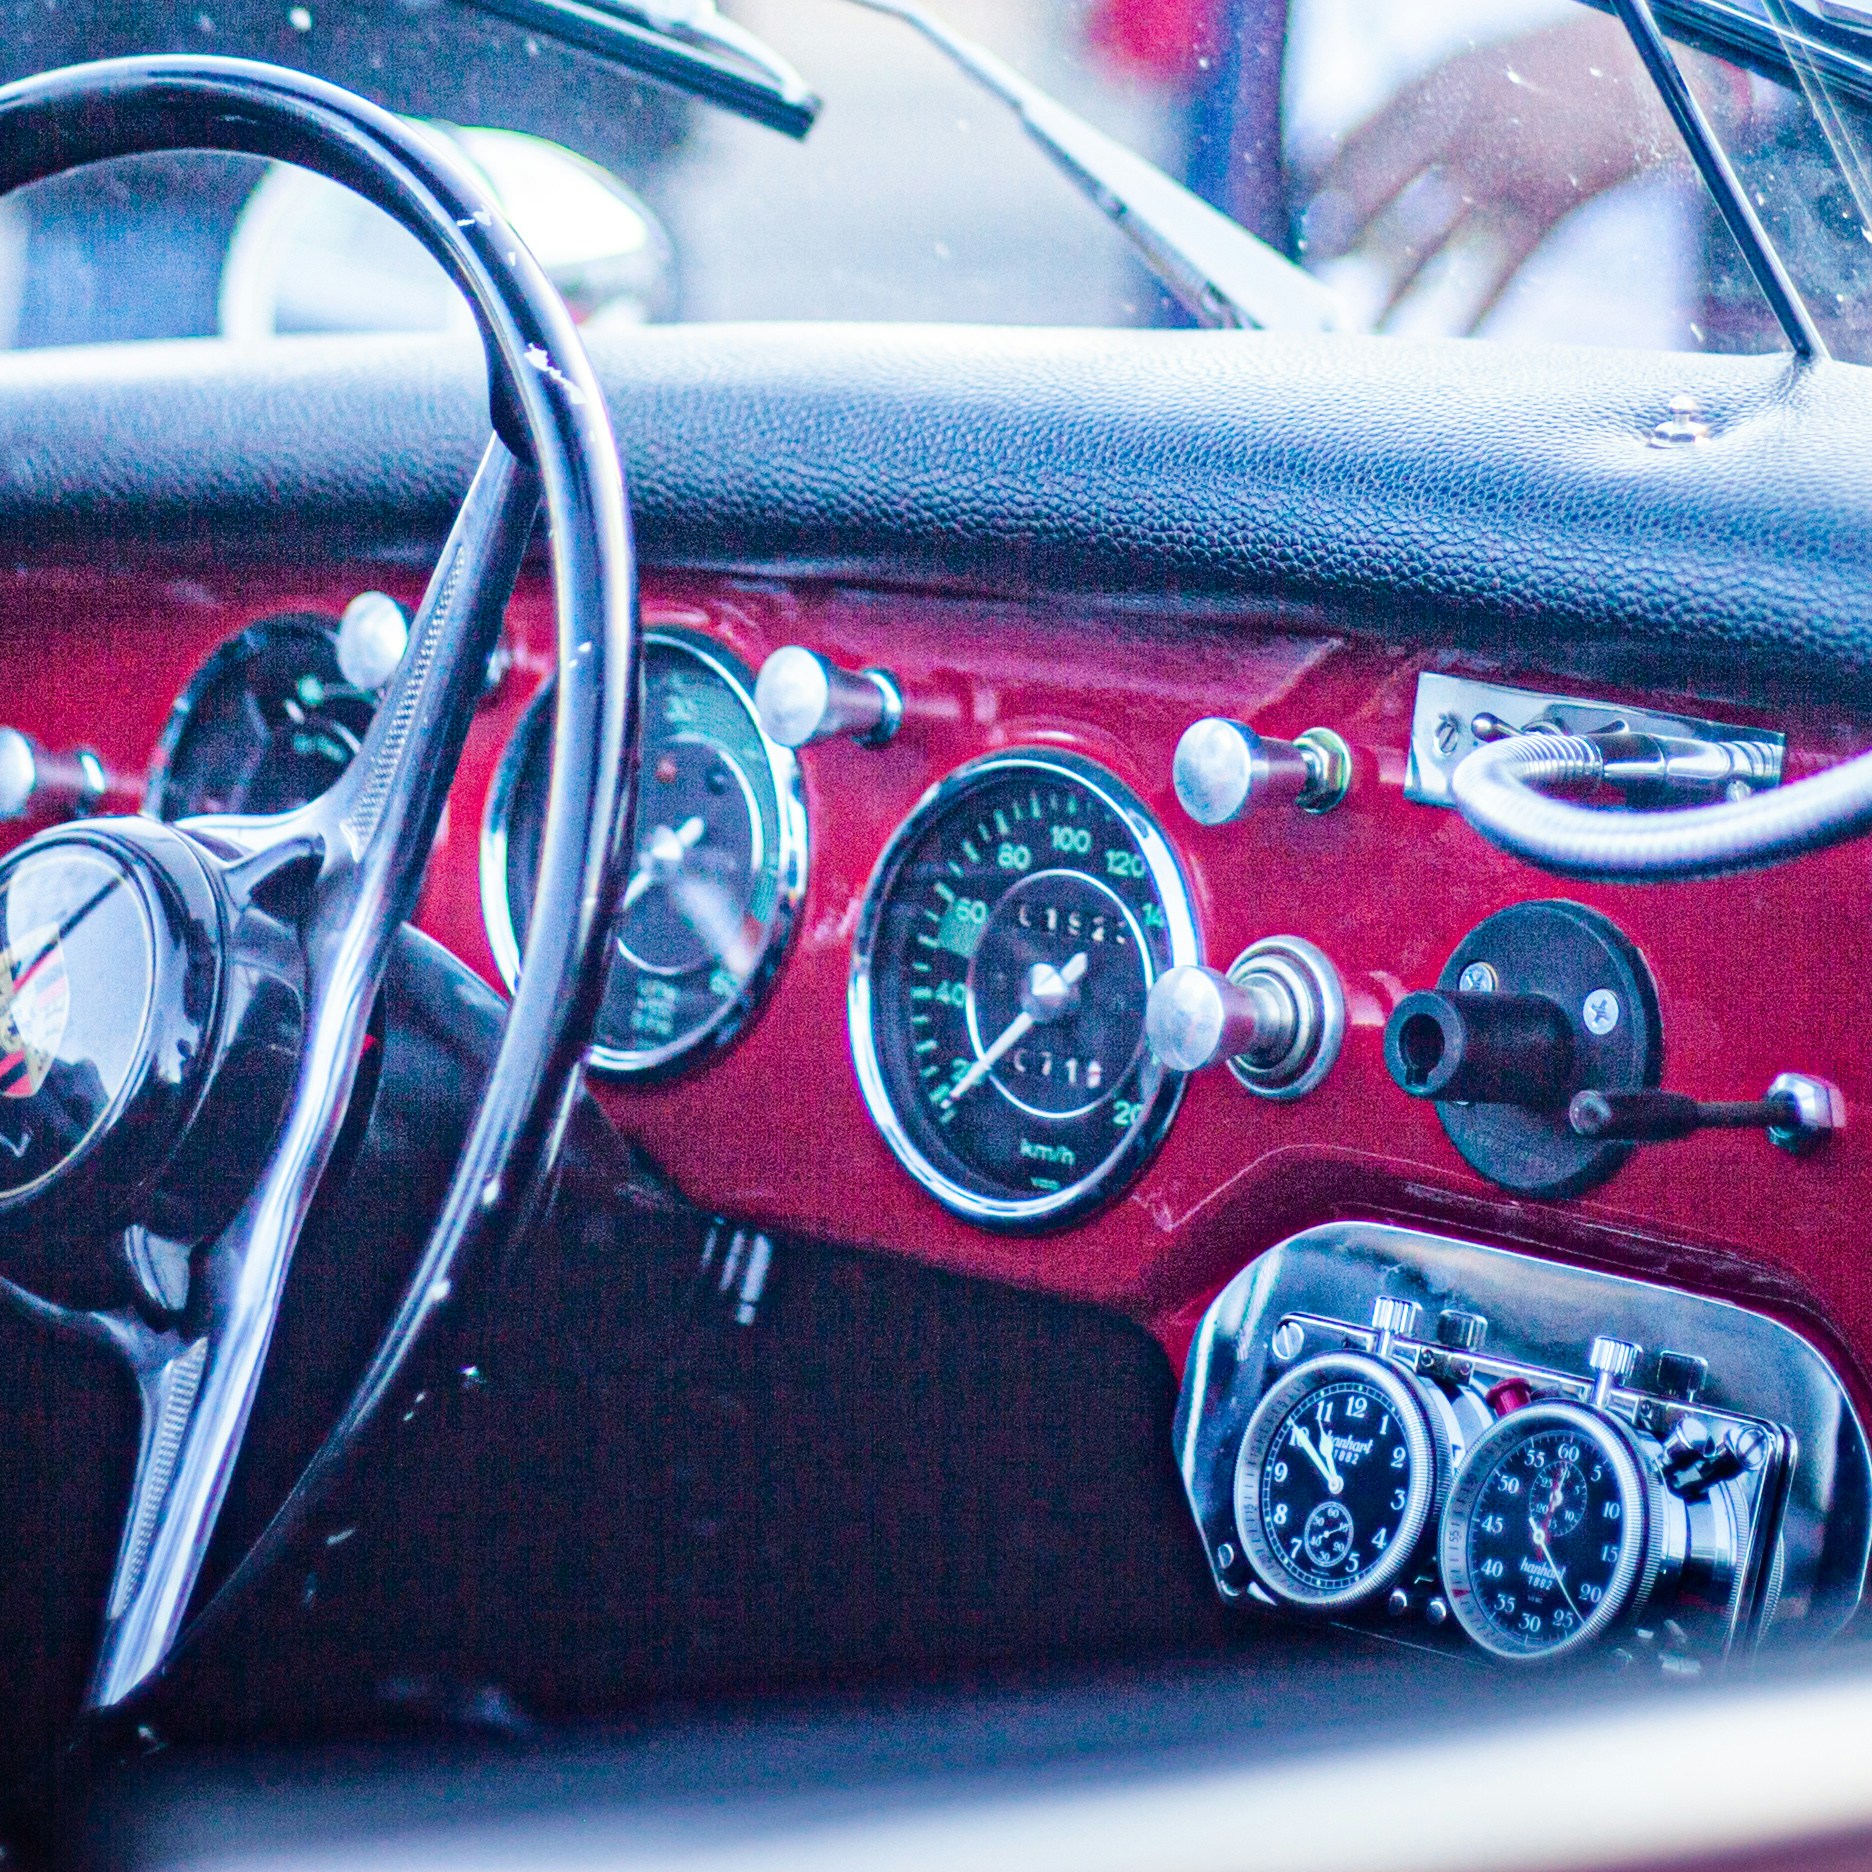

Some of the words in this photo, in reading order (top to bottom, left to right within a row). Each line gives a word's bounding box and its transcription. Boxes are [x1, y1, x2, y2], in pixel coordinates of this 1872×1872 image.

[1050, 826, 1092, 854] 100
[997, 842, 1031, 871] 80
[1106, 849, 1145, 878] 120
[955, 896, 989, 925] 60
[935, 982, 967, 1007] 40
[1315, 1400, 1334, 1422] 11
[1346, 1395, 1368, 1418] 12
[1380, 1415, 1388, 1435] 1
[1334, 1449, 1359, 1466] 1882
[1391, 1447, 1406, 1468] 2
[1524, 1449, 1545, 1468] 55
[1558, 1443, 1579, 1462] 60
[1274, 1462, 1288, 1482] 9
[1590, 1465, 1602, 1482] 5
[1497, 1475, 1519, 1495] 50
[1540, 1477, 1553, 1488] 25
[1390, 1490, 1405, 1510] 3
[1602, 1501, 1621, 1519] 10
[1273, 1504, 1288, 1524] 8
[1327, 1508, 1339, 1518] 60
[1564, 1510, 1575, 1522] 10
[1481, 1515, 1504, 1534] 45
[1290, 1538, 1303, 1559] 7
[1333, 1542, 1344, 1552] 20
[1371, 1528, 1387, 1549] 4
[1345, 1552, 1360, 1573] 5
[1601, 1545, 1619, 1563] 15
[1480, 1559, 1504, 1577] 40
[1528, 1575, 1553, 1591] 1882
[1578, 1583, 1602, 1604] 20
[1494, 1594, 1516, 1614] 35
[1518, 1613, 1541, 1632] 30
[1553, 1609, 1574, 1629] 25
